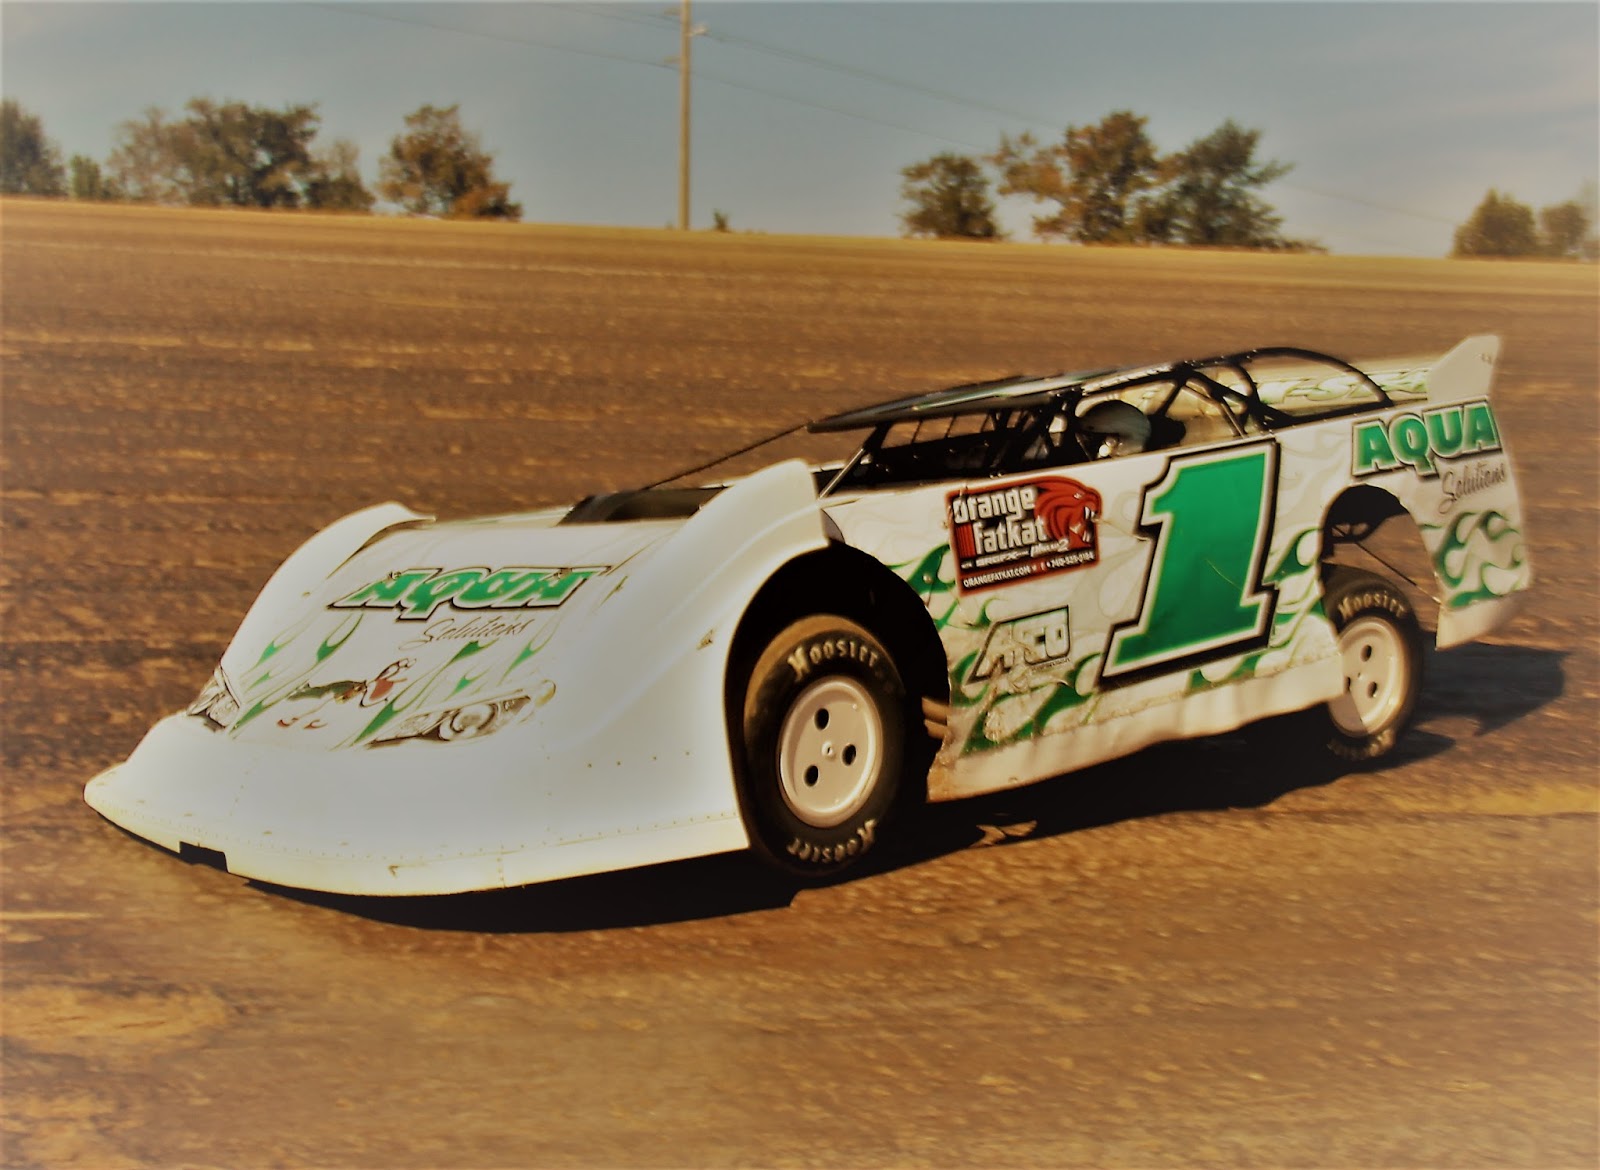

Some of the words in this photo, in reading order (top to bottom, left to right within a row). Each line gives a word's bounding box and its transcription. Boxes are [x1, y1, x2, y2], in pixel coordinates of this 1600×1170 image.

[1352, 401, 1503, 481] AQUA
[1439, 463, 1506, 514] Solutions
[1093, 438, 1281, 690] 1
